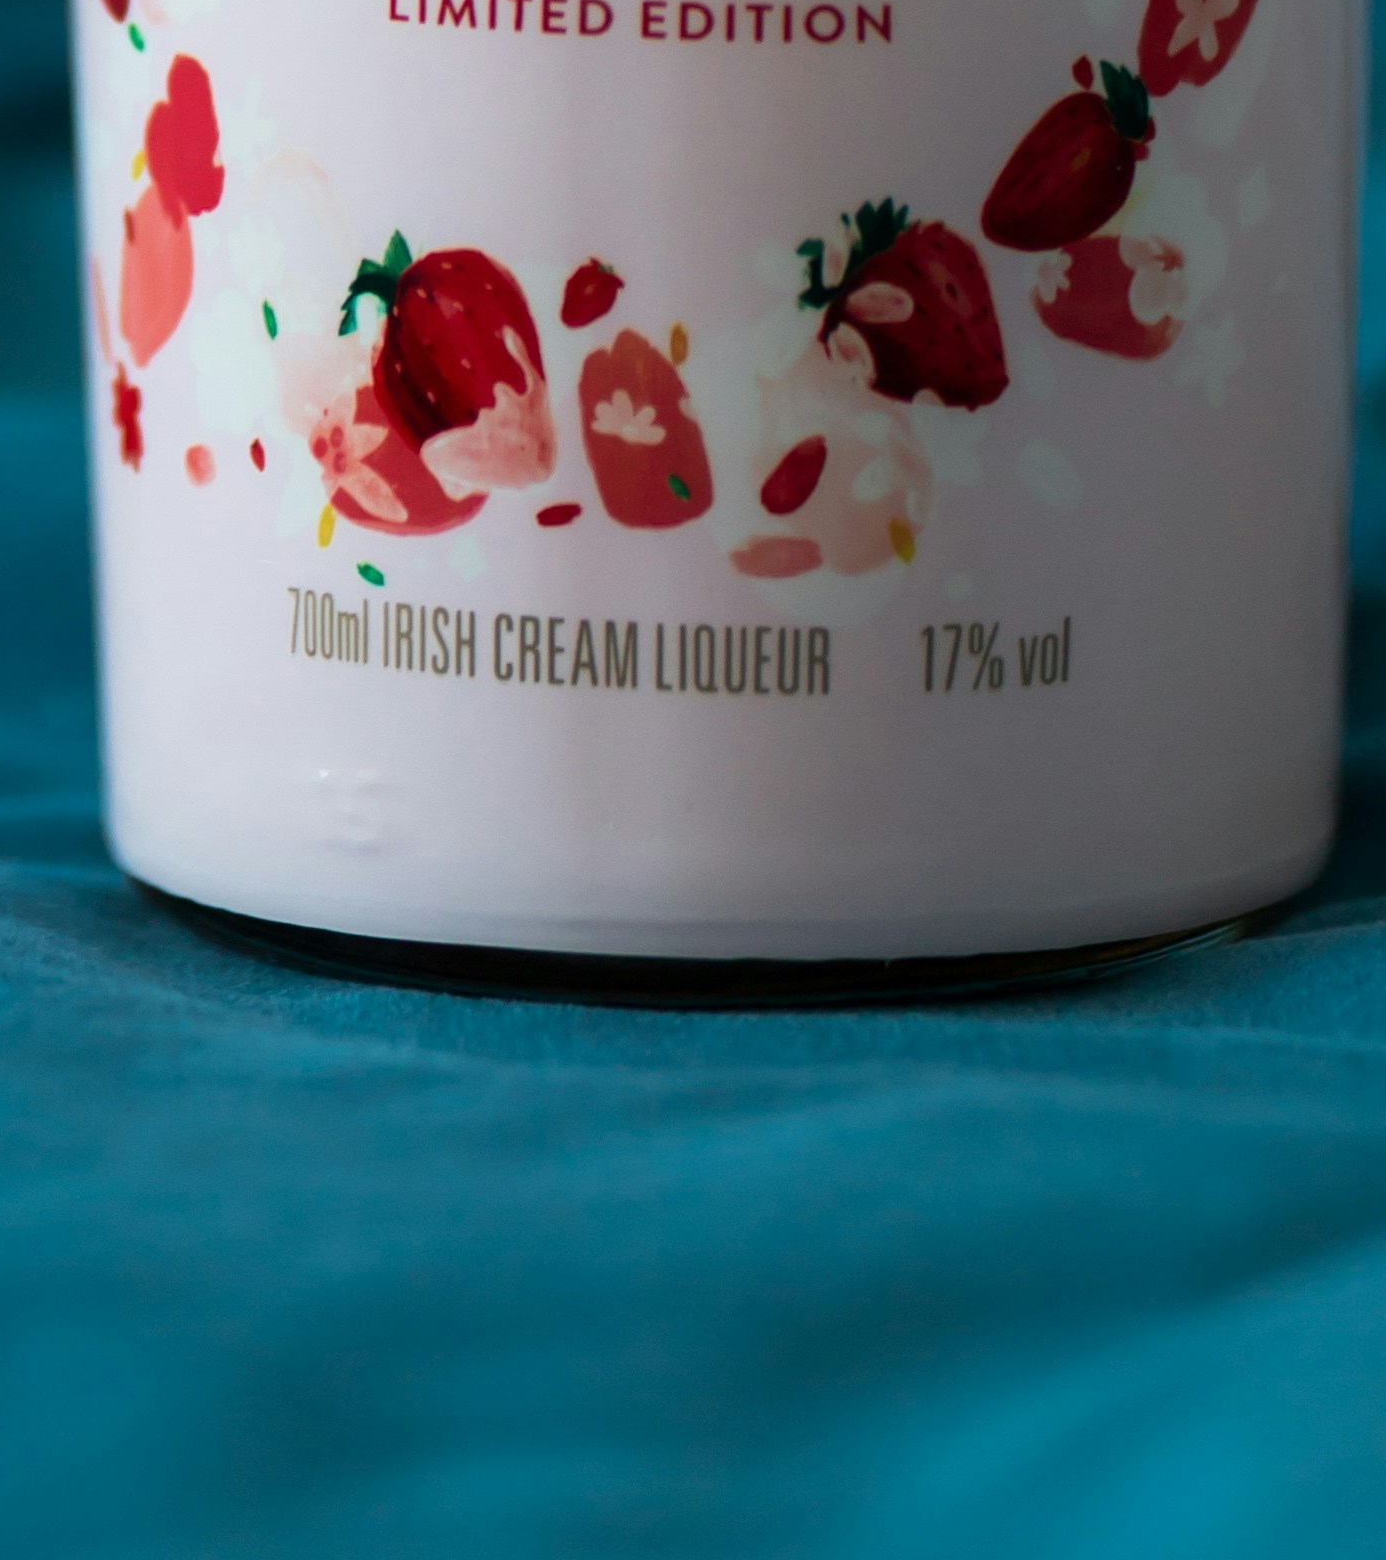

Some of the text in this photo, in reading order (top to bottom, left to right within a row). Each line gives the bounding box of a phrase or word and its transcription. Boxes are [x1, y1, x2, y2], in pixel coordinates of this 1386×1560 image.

[641, 0, 893, 44] EDITION
[286, 587, 1072, 696] 700ml IRISH CREAM LIQUEUR 17% vol
